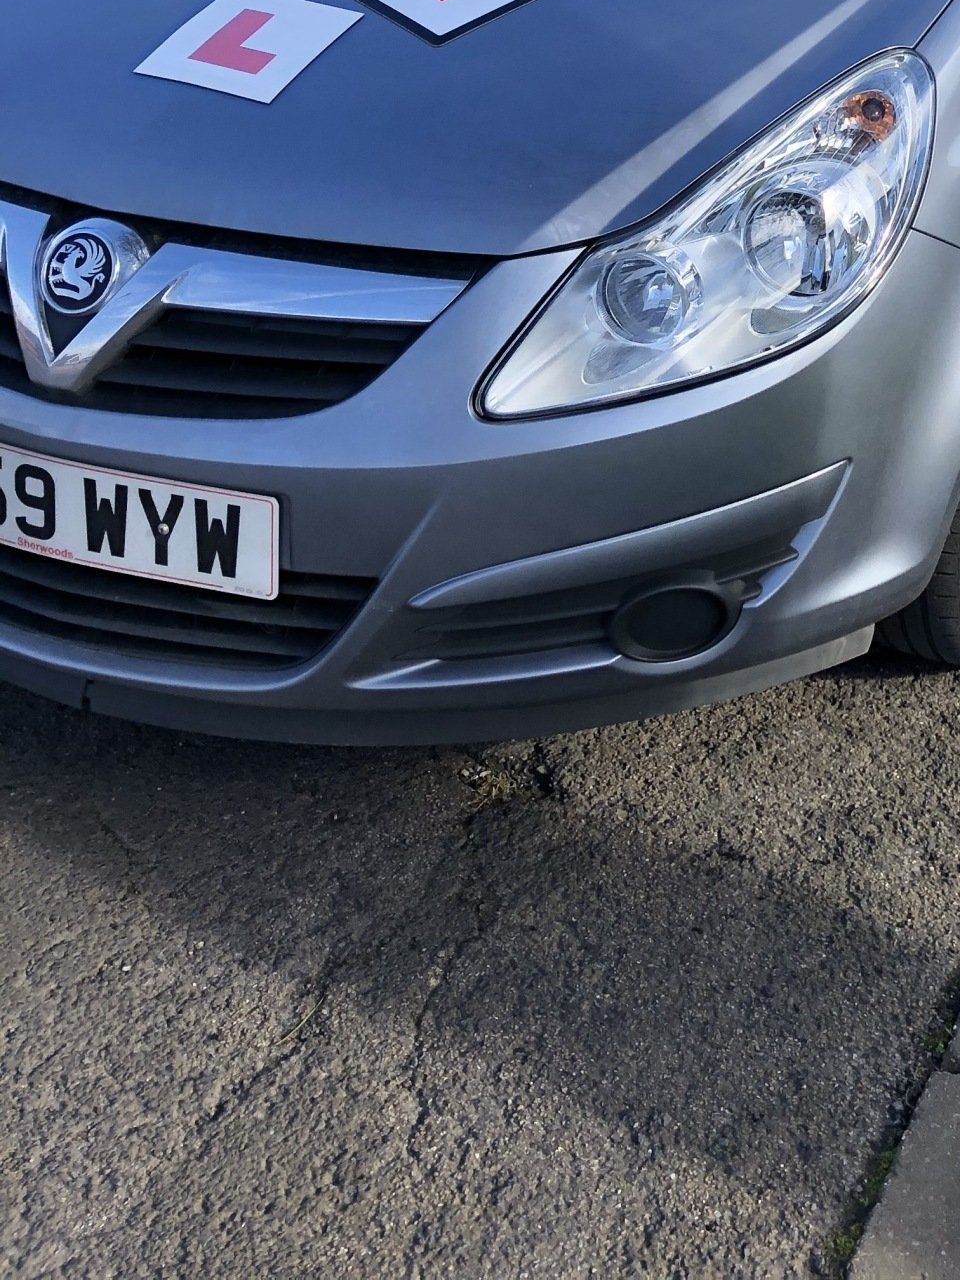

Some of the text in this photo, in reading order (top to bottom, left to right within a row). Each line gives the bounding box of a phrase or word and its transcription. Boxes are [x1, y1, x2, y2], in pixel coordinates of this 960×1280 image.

[187, 8, 278, 75] L
[0, 456, 241, 578] 9 WYW
[17, 536, 74, 559] Sherwoods
